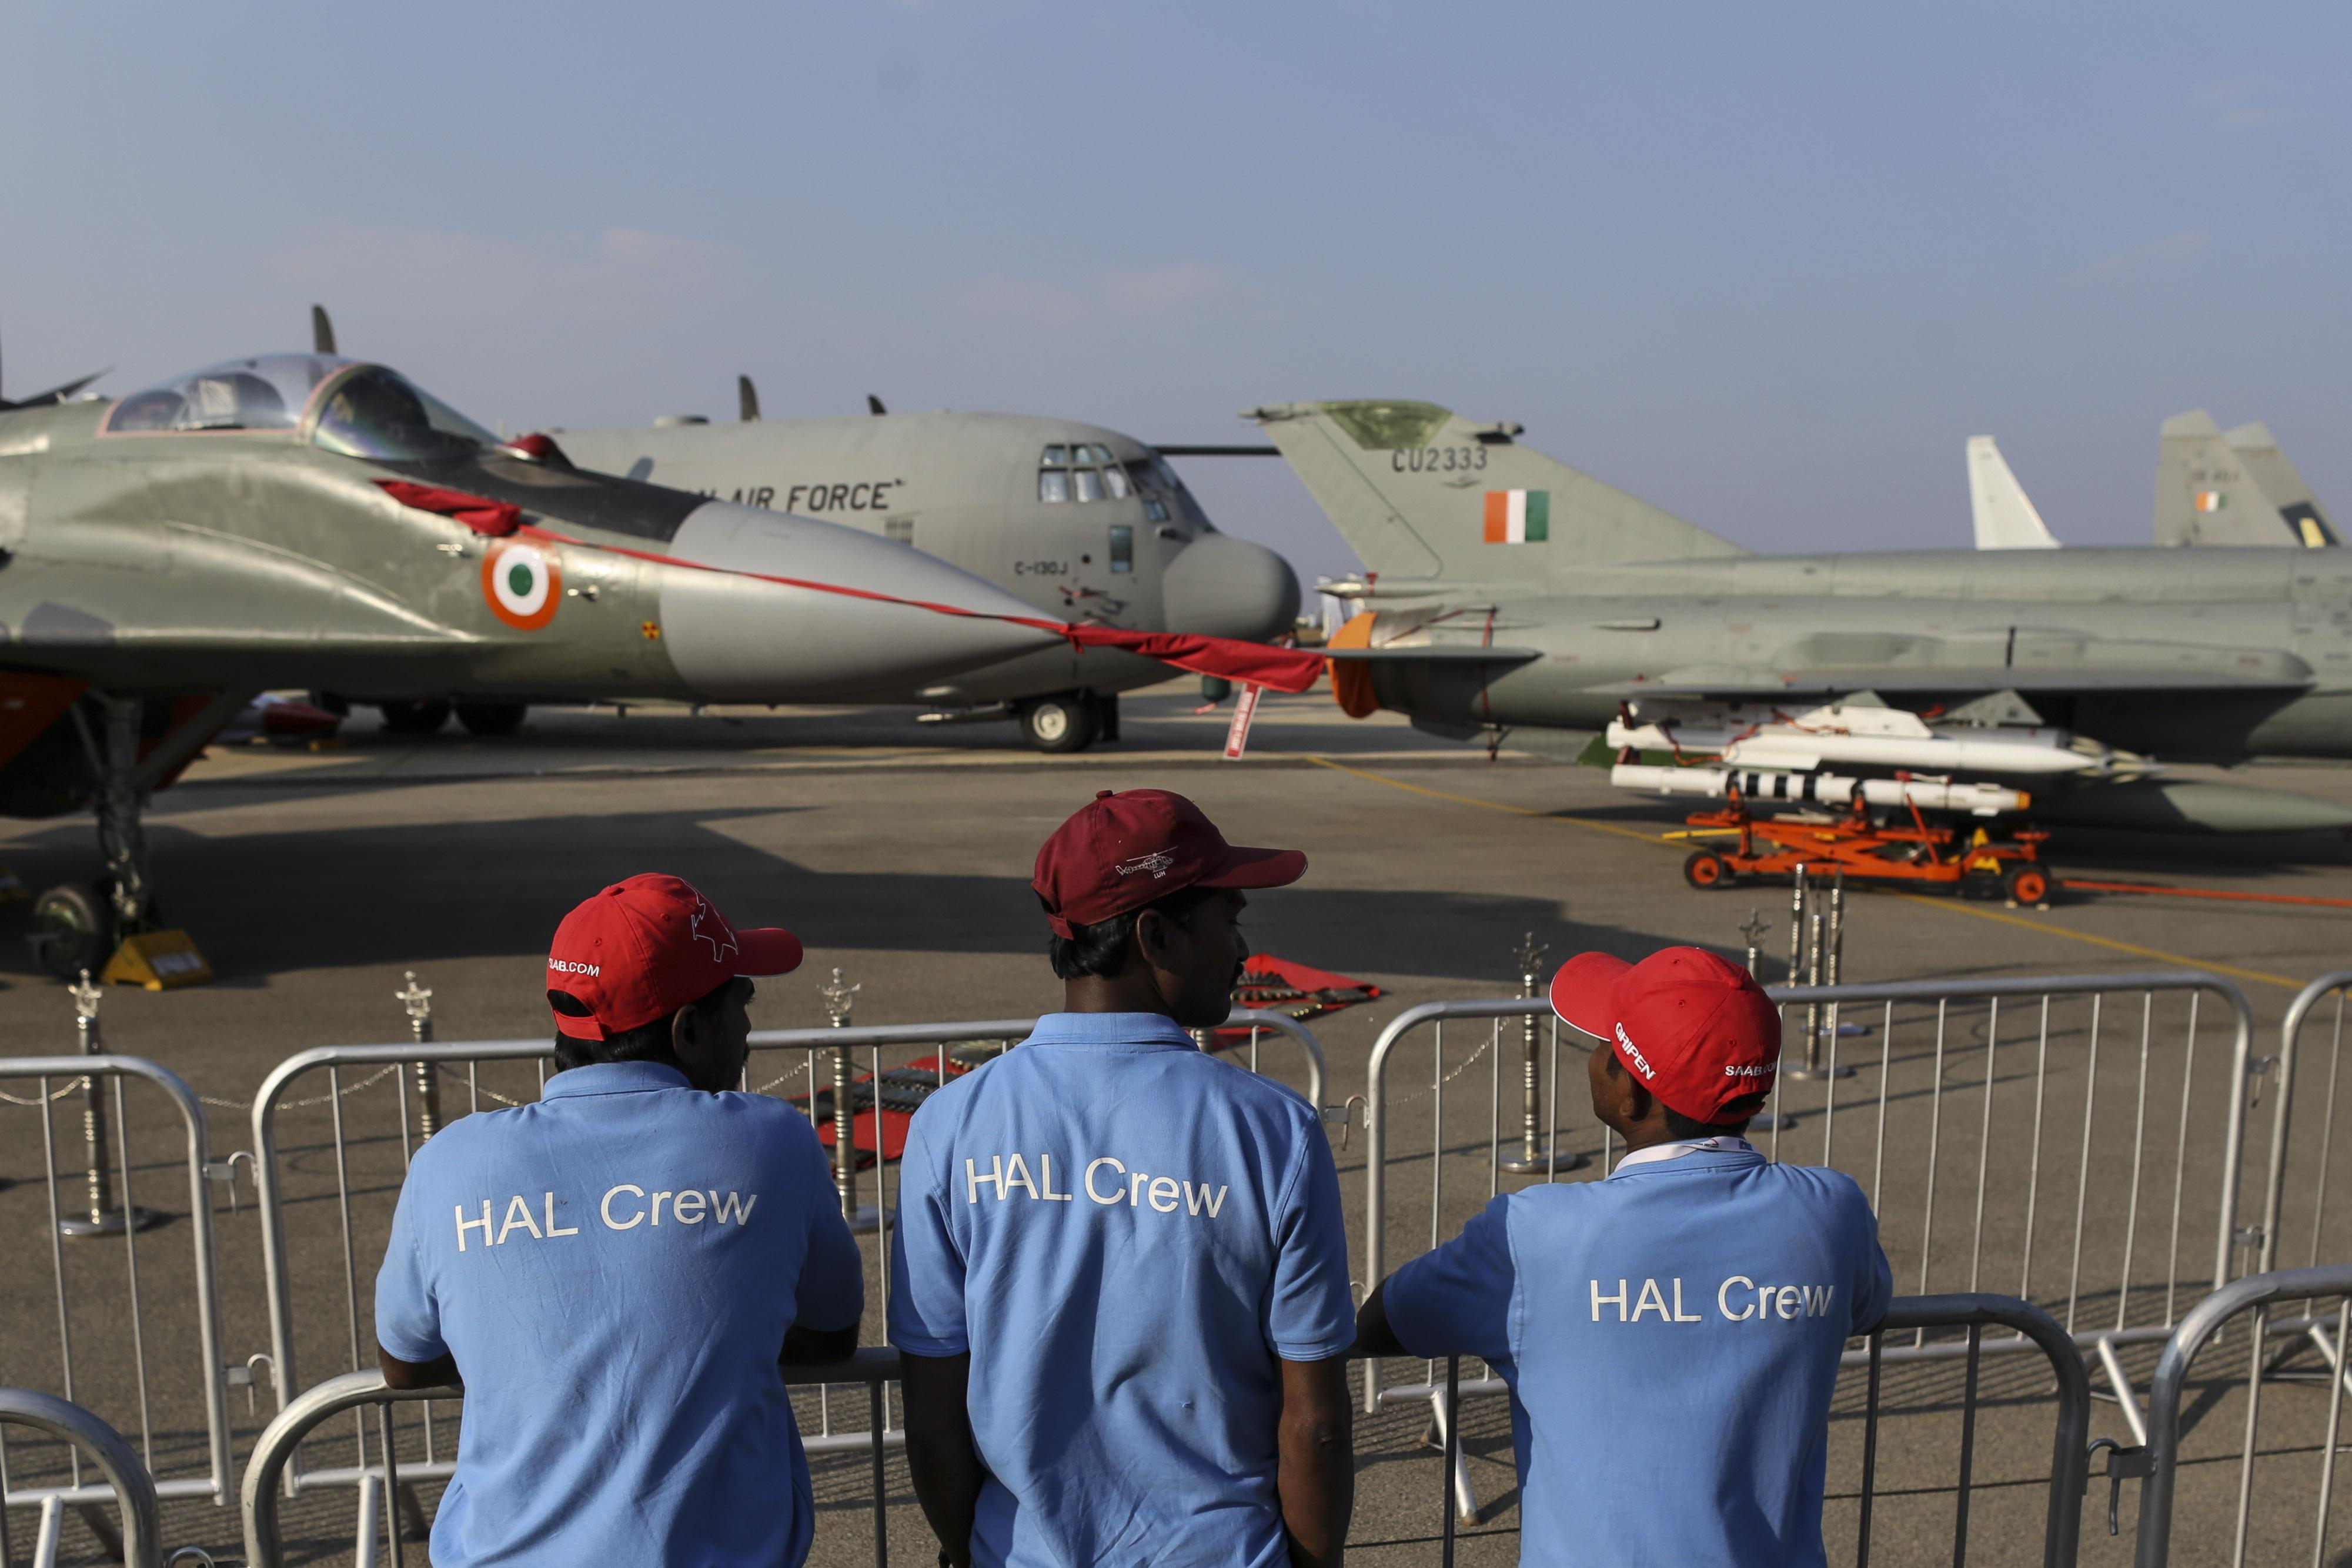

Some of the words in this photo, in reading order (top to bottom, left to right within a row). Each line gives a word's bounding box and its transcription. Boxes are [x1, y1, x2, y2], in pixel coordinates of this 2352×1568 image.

[1392, 446, 1487, 472] CU2333
[786, 482, 893, 514] FORCE
[1154, 870, 1166, 879] LUH
[1615, 1022, 1656, 1080] GRIPEN
[965, 1153, 1072, 1204] HAL
[1085, 1156, 1229, 1219] Crew
[455, 1191, 579, 1252] HAL
[600, 1183, 758, 1231] Crew
[1590, 1277, 1702, 1322] HAL
[1718, 1275, 1835, 1322] Crew
